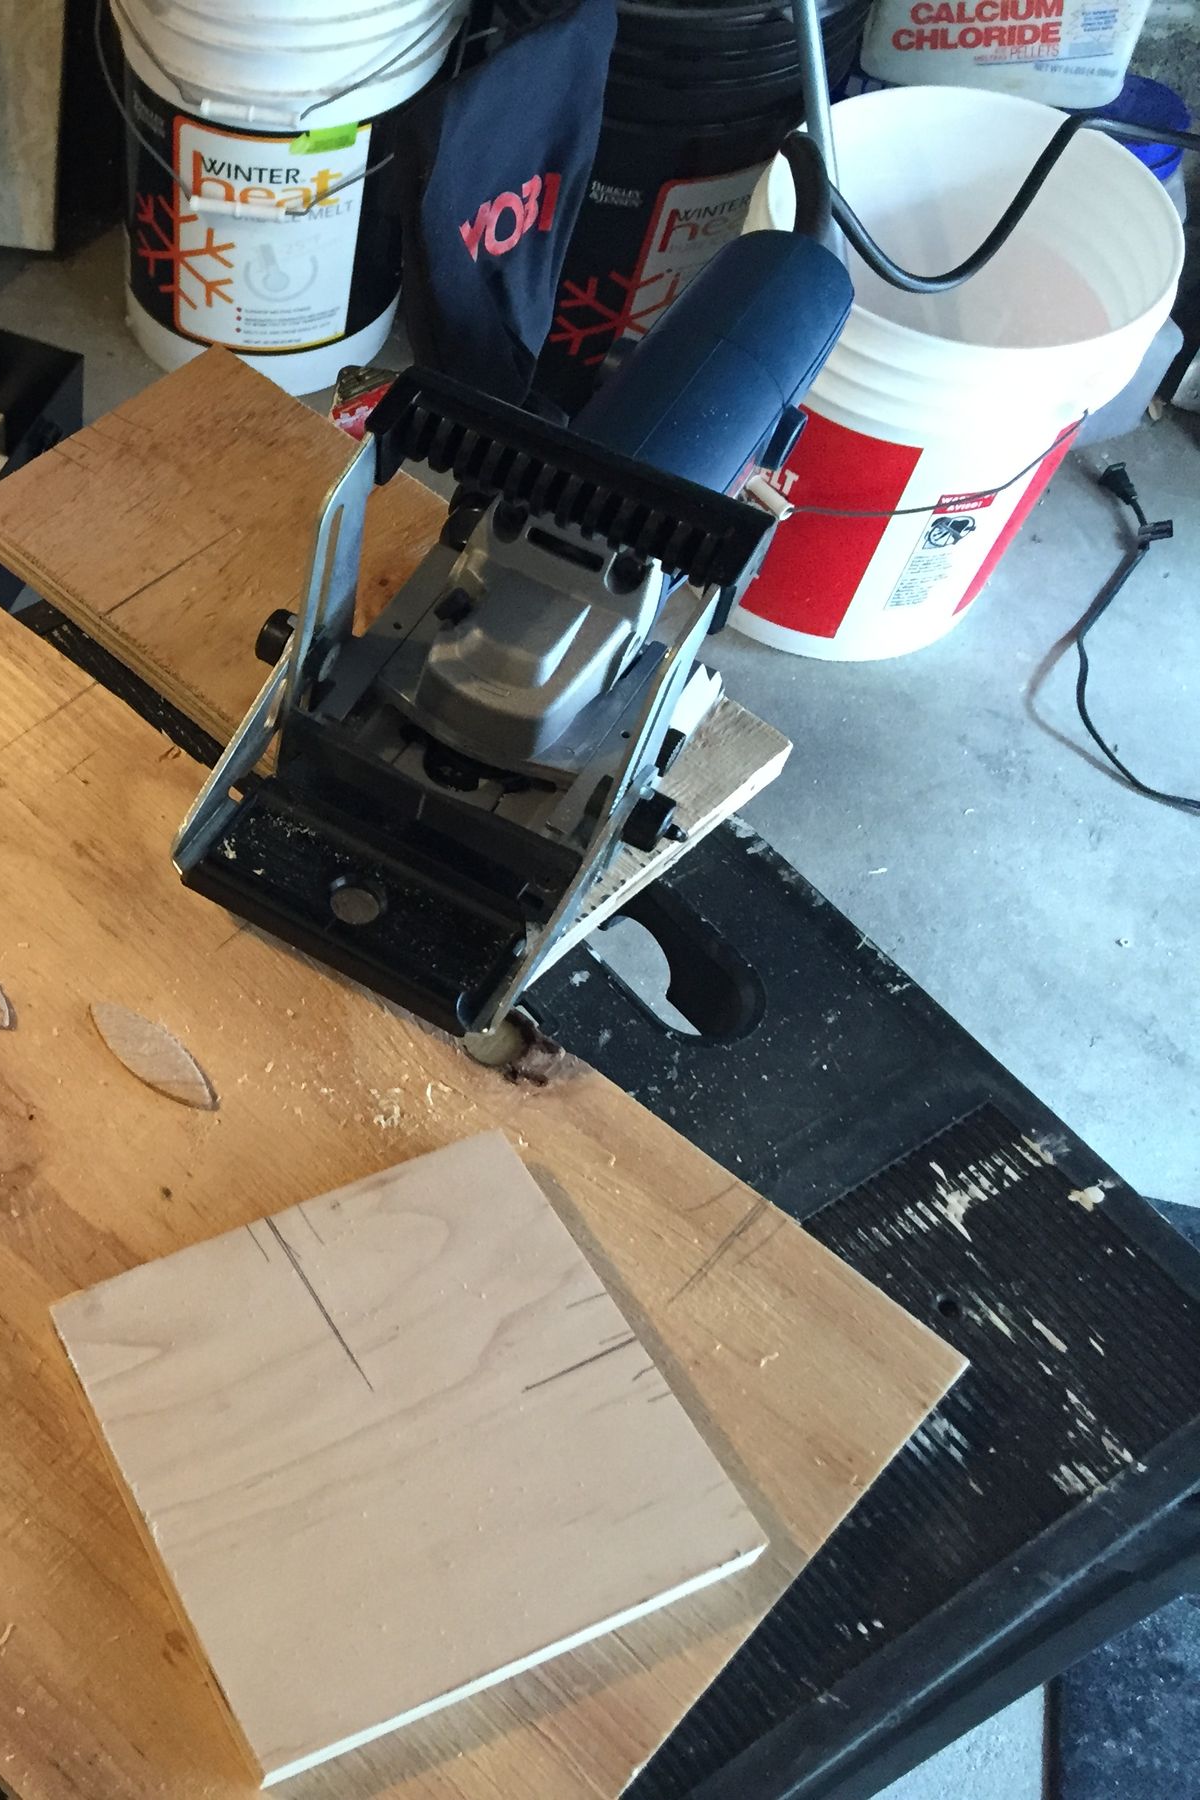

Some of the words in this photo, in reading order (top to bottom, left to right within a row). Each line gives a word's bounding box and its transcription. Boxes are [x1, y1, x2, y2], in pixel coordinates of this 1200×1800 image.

[910, 0, 1064, 25] CALCIUM
[892, 21, 1063, 51] CHLORIDE
[1010, 44, 1060, 59] PELLETS
[192, 150, 343, 208] heat
[201, 155, 300, 184] WINTER
[308, 199, 353, 221] MELT
[675, 194, 752, 222] WINTER
